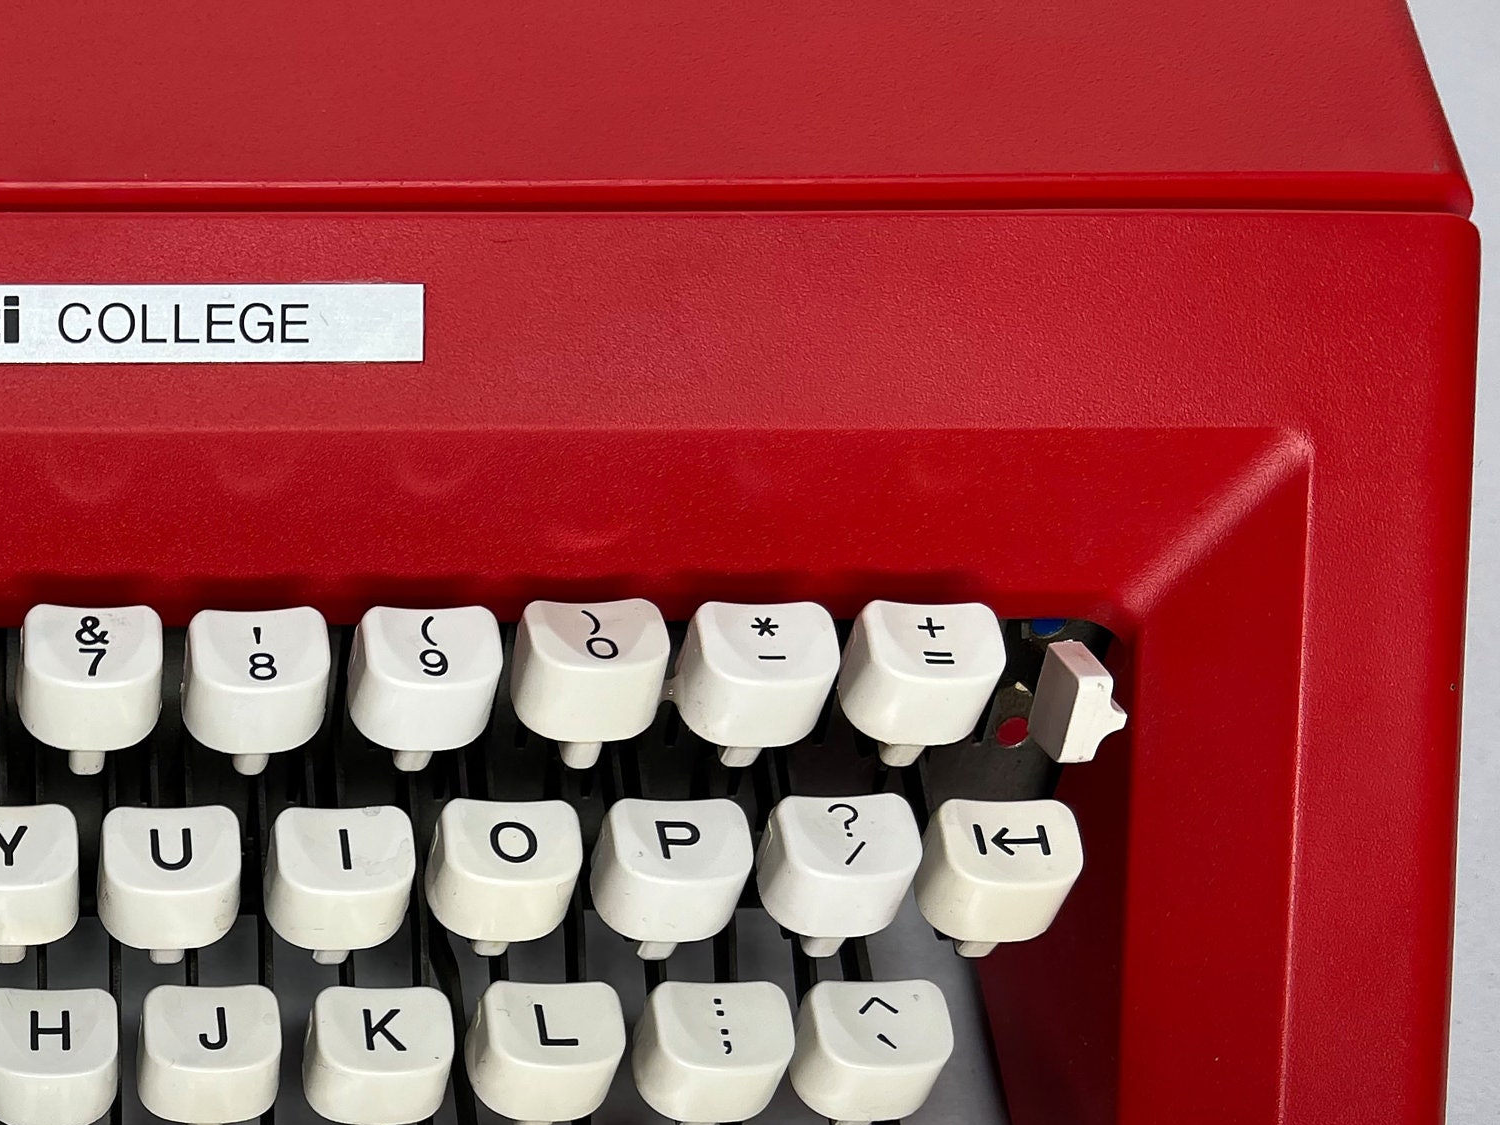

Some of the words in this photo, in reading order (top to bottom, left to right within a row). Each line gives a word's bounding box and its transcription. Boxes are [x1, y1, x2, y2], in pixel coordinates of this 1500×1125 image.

[58, 302, 310, 344] COLLEGE
[74, 615, 110, 646] &
[917, 616, 945, 639] +
[78, 647, 107, 677] 7
[248, 652, 278, 681] 8
[419, 648, 449, 677] 9
[654, 820, 701, 860] P
[827, 803, 859, 838] ?
[149, 827, 193, 871] U
[338, 828, 353, 871] I
[489, 821, 538, 864] O
[29, 1010, 71, 1052] H
[198, 1006, 228, 1051] J
[362, 1008, 407, 1052] K
[533, 1003, 579, 1047] L
